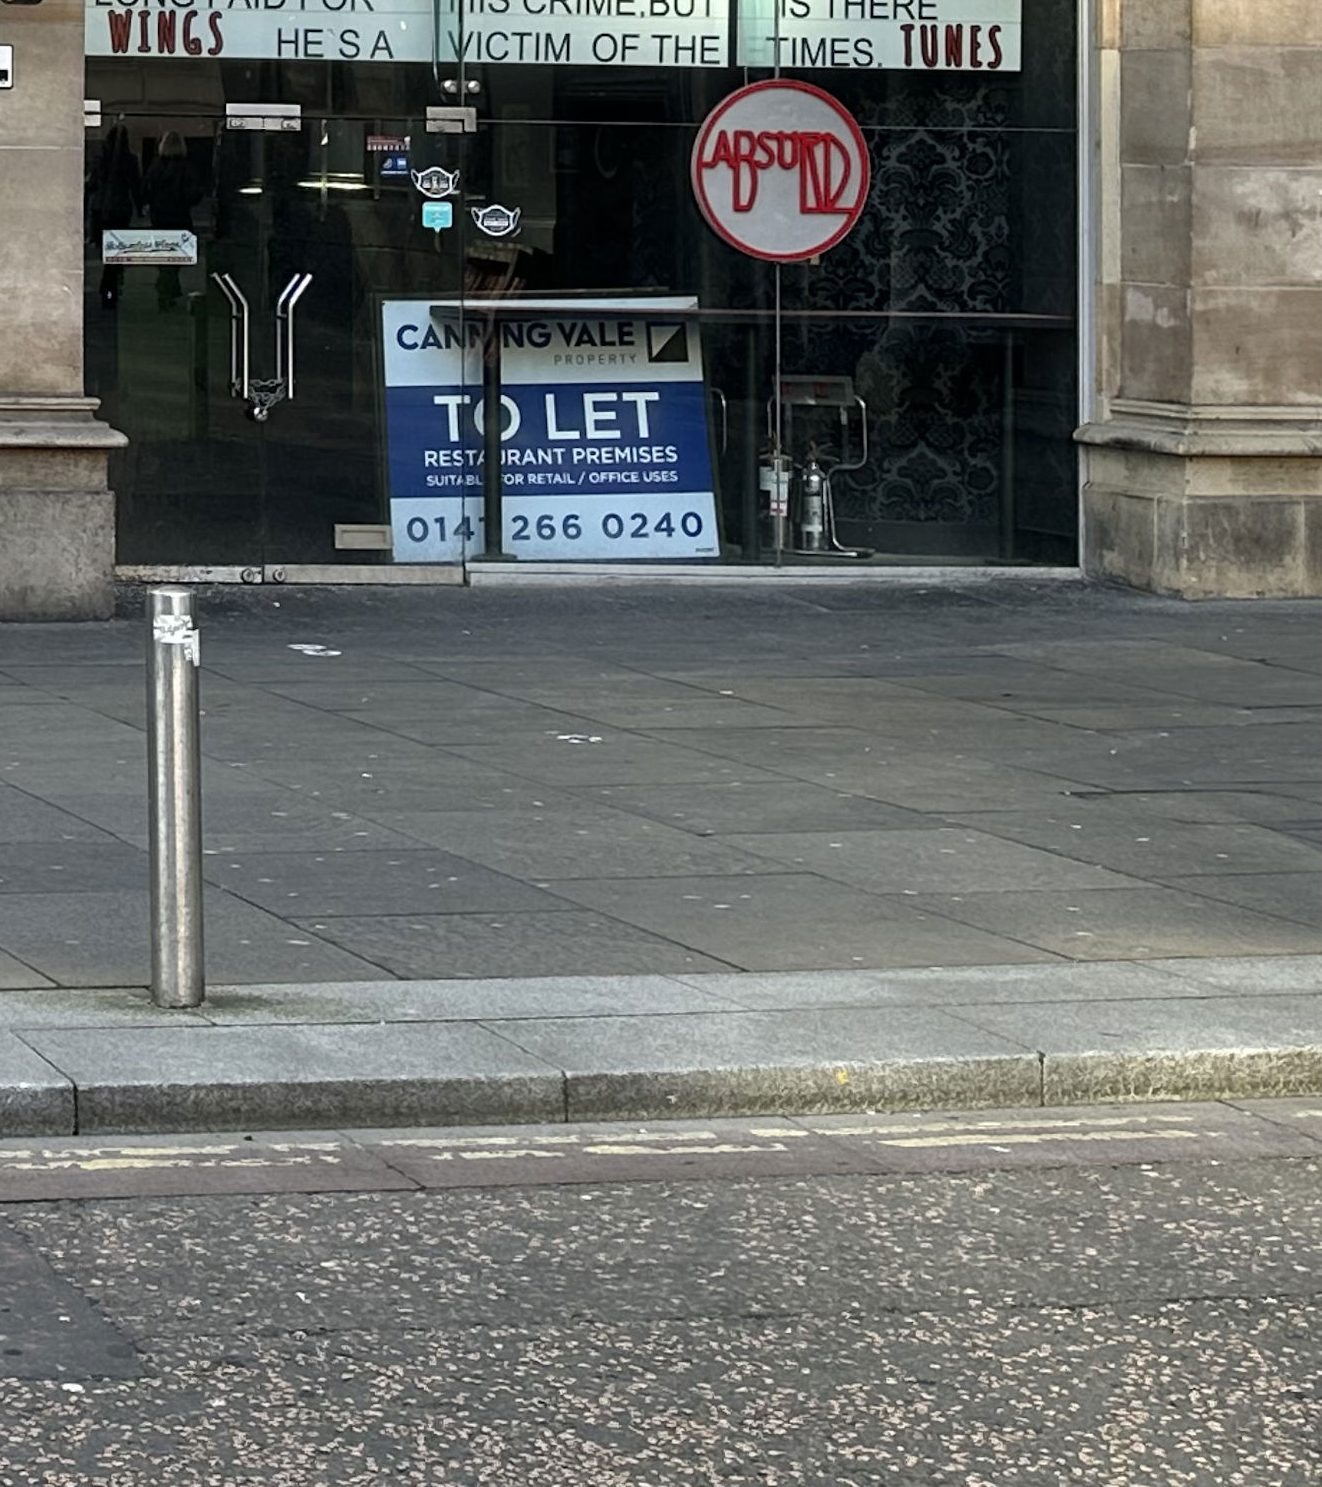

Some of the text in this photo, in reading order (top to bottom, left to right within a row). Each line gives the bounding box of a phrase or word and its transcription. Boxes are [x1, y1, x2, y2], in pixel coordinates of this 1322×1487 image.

[108, 9, 224, 56] WINGS
[370, 30, 394, 59] A
[448, 31, 720, 65] VICTIM OF THE
[900, 24, 1003, 69] TUNES
[557, 322, 635, 347] VALE
[553, 354, 637, 365] PROPERTY
[434, 391, 660, 443] TO LET
[572, 446, 678, 464] PREMISES
[426, 474, 484, 487] SUITABL
[527, 473, 575, 485] RETAIL
[589, 471, 638, 484] OFFICE
[643, 470, 678, 483] USES
[407, 511, 703, 543] 014 266 0240
